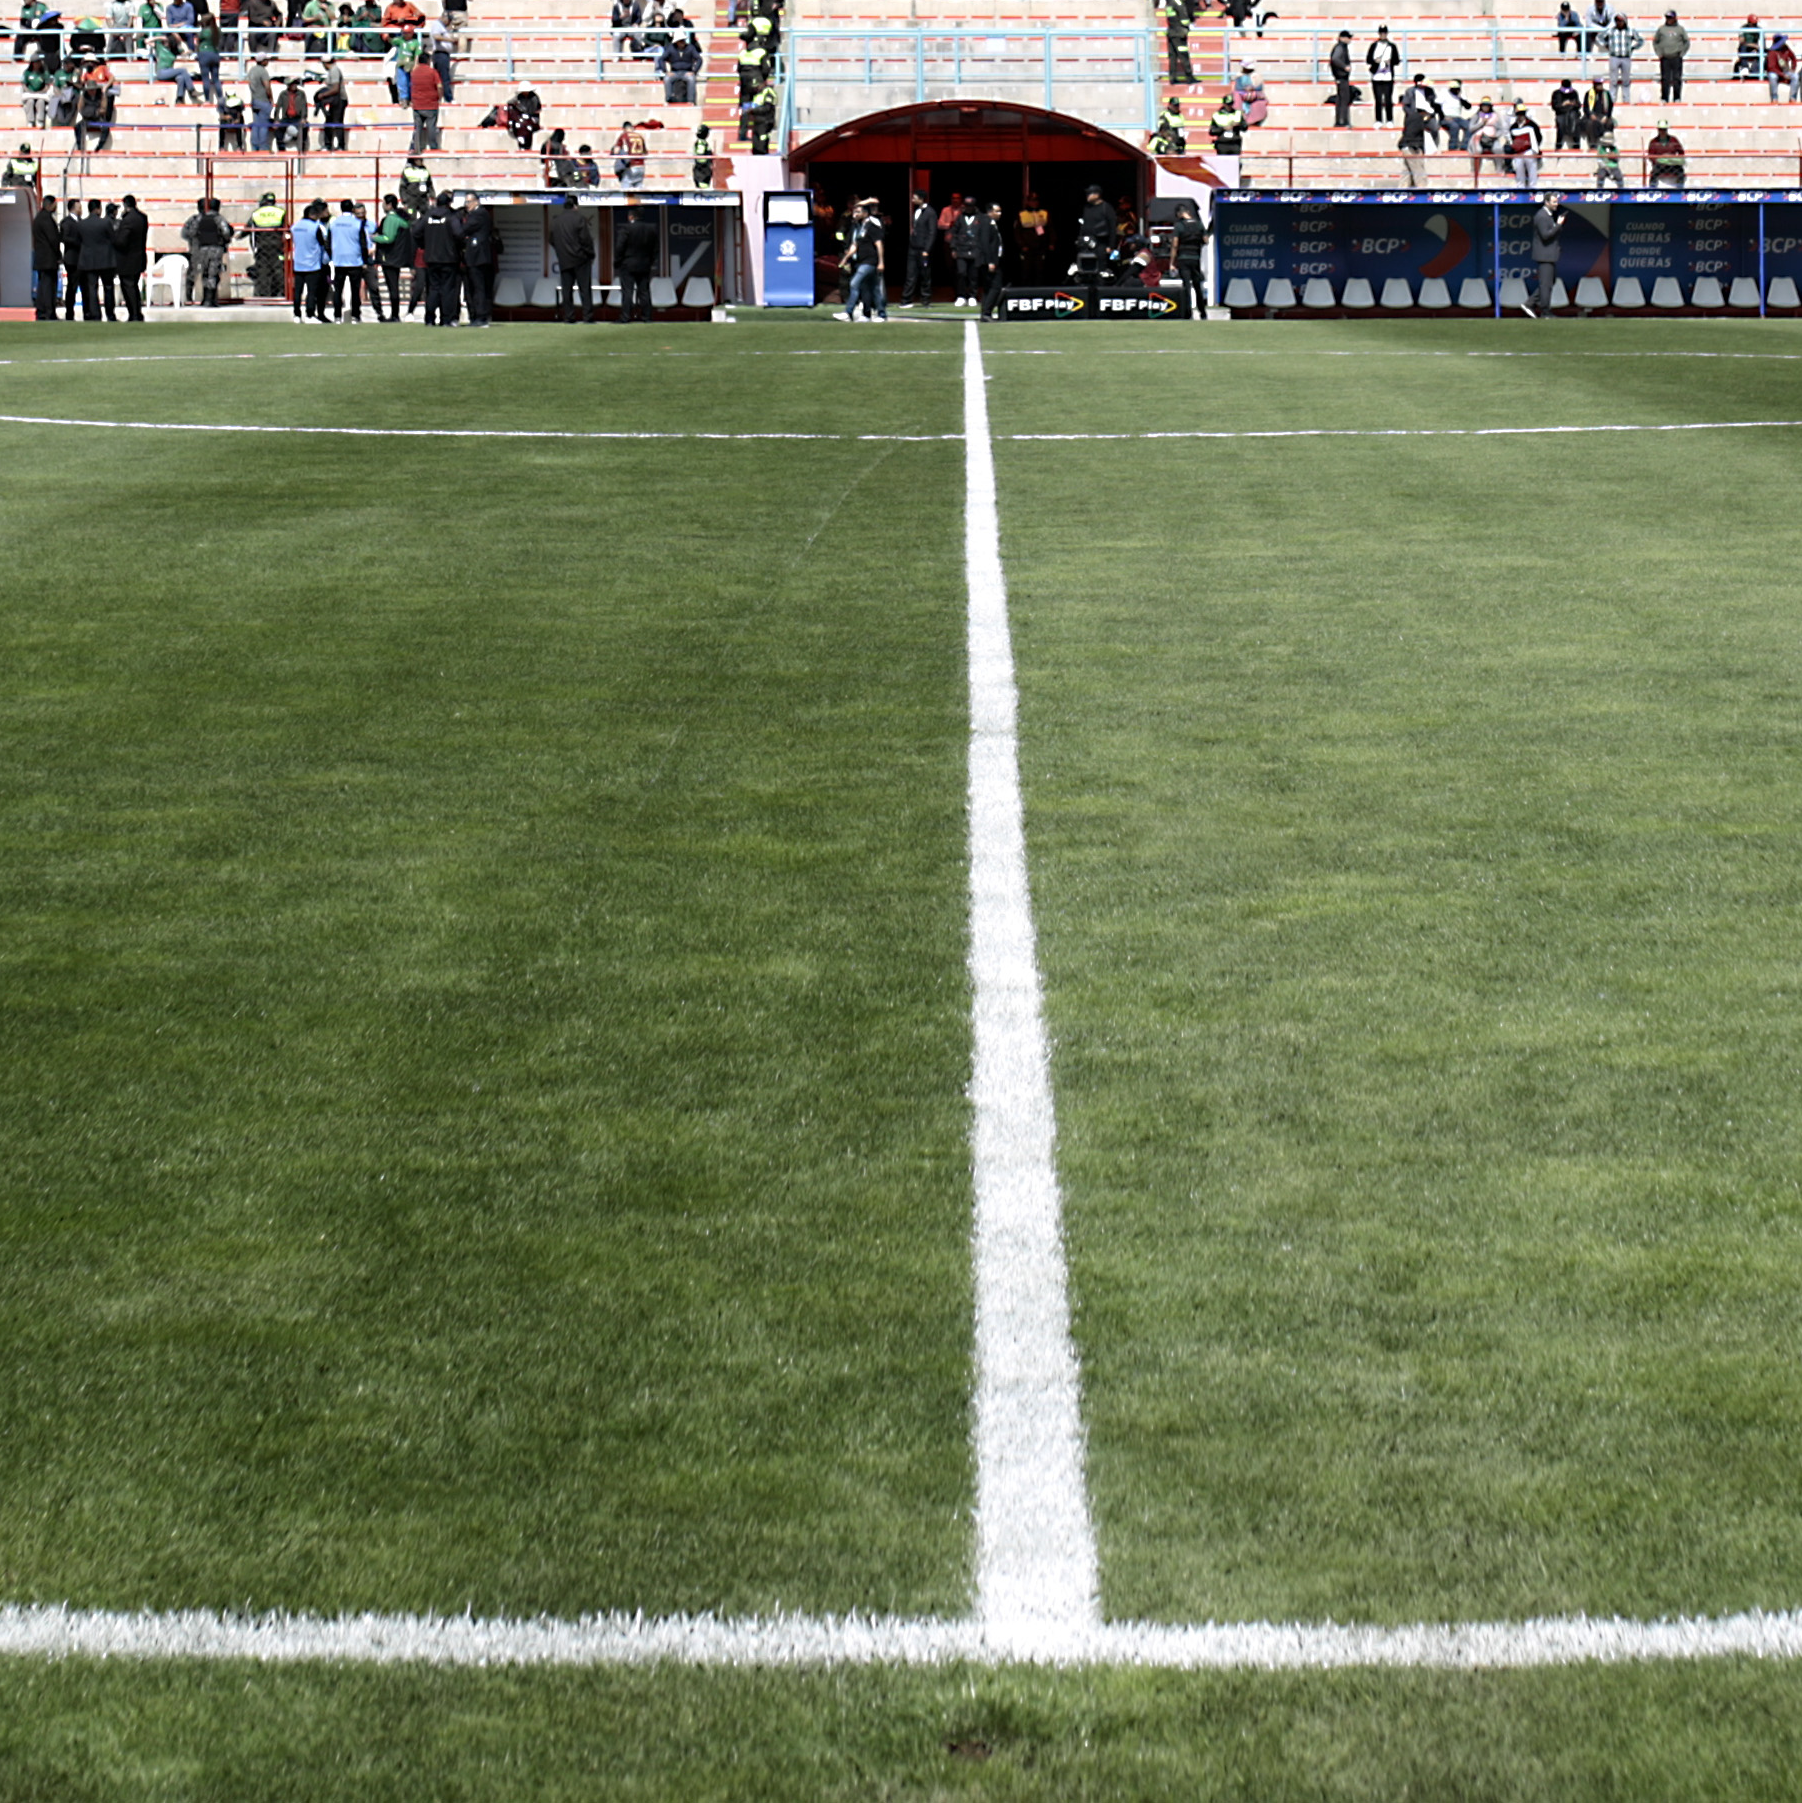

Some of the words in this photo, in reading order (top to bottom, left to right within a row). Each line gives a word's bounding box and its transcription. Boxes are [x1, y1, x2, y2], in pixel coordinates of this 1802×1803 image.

[1230, 191, 1255, 202] BCP
[1281, 191, 1306, 202] BCP
[1332, 191, 1357, 202] BCP
[1383, 191, 1408, 202] BCP
[1433, 191, 1458, 202] BCP
[1484, 191, 1509, 202] BCP
[1586, 191, 1611, 202] BCP
[1637, 191, 1662, 202] BCP
[1687, 191, 1712, 202] BCP
[1738, 191, 1763, 202] BCP
[1300, 221, 1328, 233] BCP
[1499, 215, 1531, 228] BCP
[1626, 222, 1665, 231] CUANDO
[1695, 219, 1722, 231] BCP
[670, 222, 712, 236] Check
[1229, 223, 1268, 233] CUANDO
[1223, 234, 1274, 246] QUIERAS
[1620, 233, 1671, 244] QUIERAS
[1300, 242, 1327, 253] BCP
[1362, 238, 1399, 254] BCP
[1499, 241, 1531, 255] BCP
[1629, 247, 1661, 256] DONDE
[1695, 240, 1723, 252] BCP
[1232, 248, 1265, 257] DONDE
[1223, 259, 1275, 270] QUIERAS
[1620, 257, 1671, 268] QUIERAS
[1695, 260, 1723, 273] BCP
[1300, 263, 1328, 275] BCP
[1007, 299, 1043, 311] FBF
[1045, 299, 1075, 310] Play
[1099, 299, 1137, 311] FBF
[1138, 299, 1168, 311] Play
